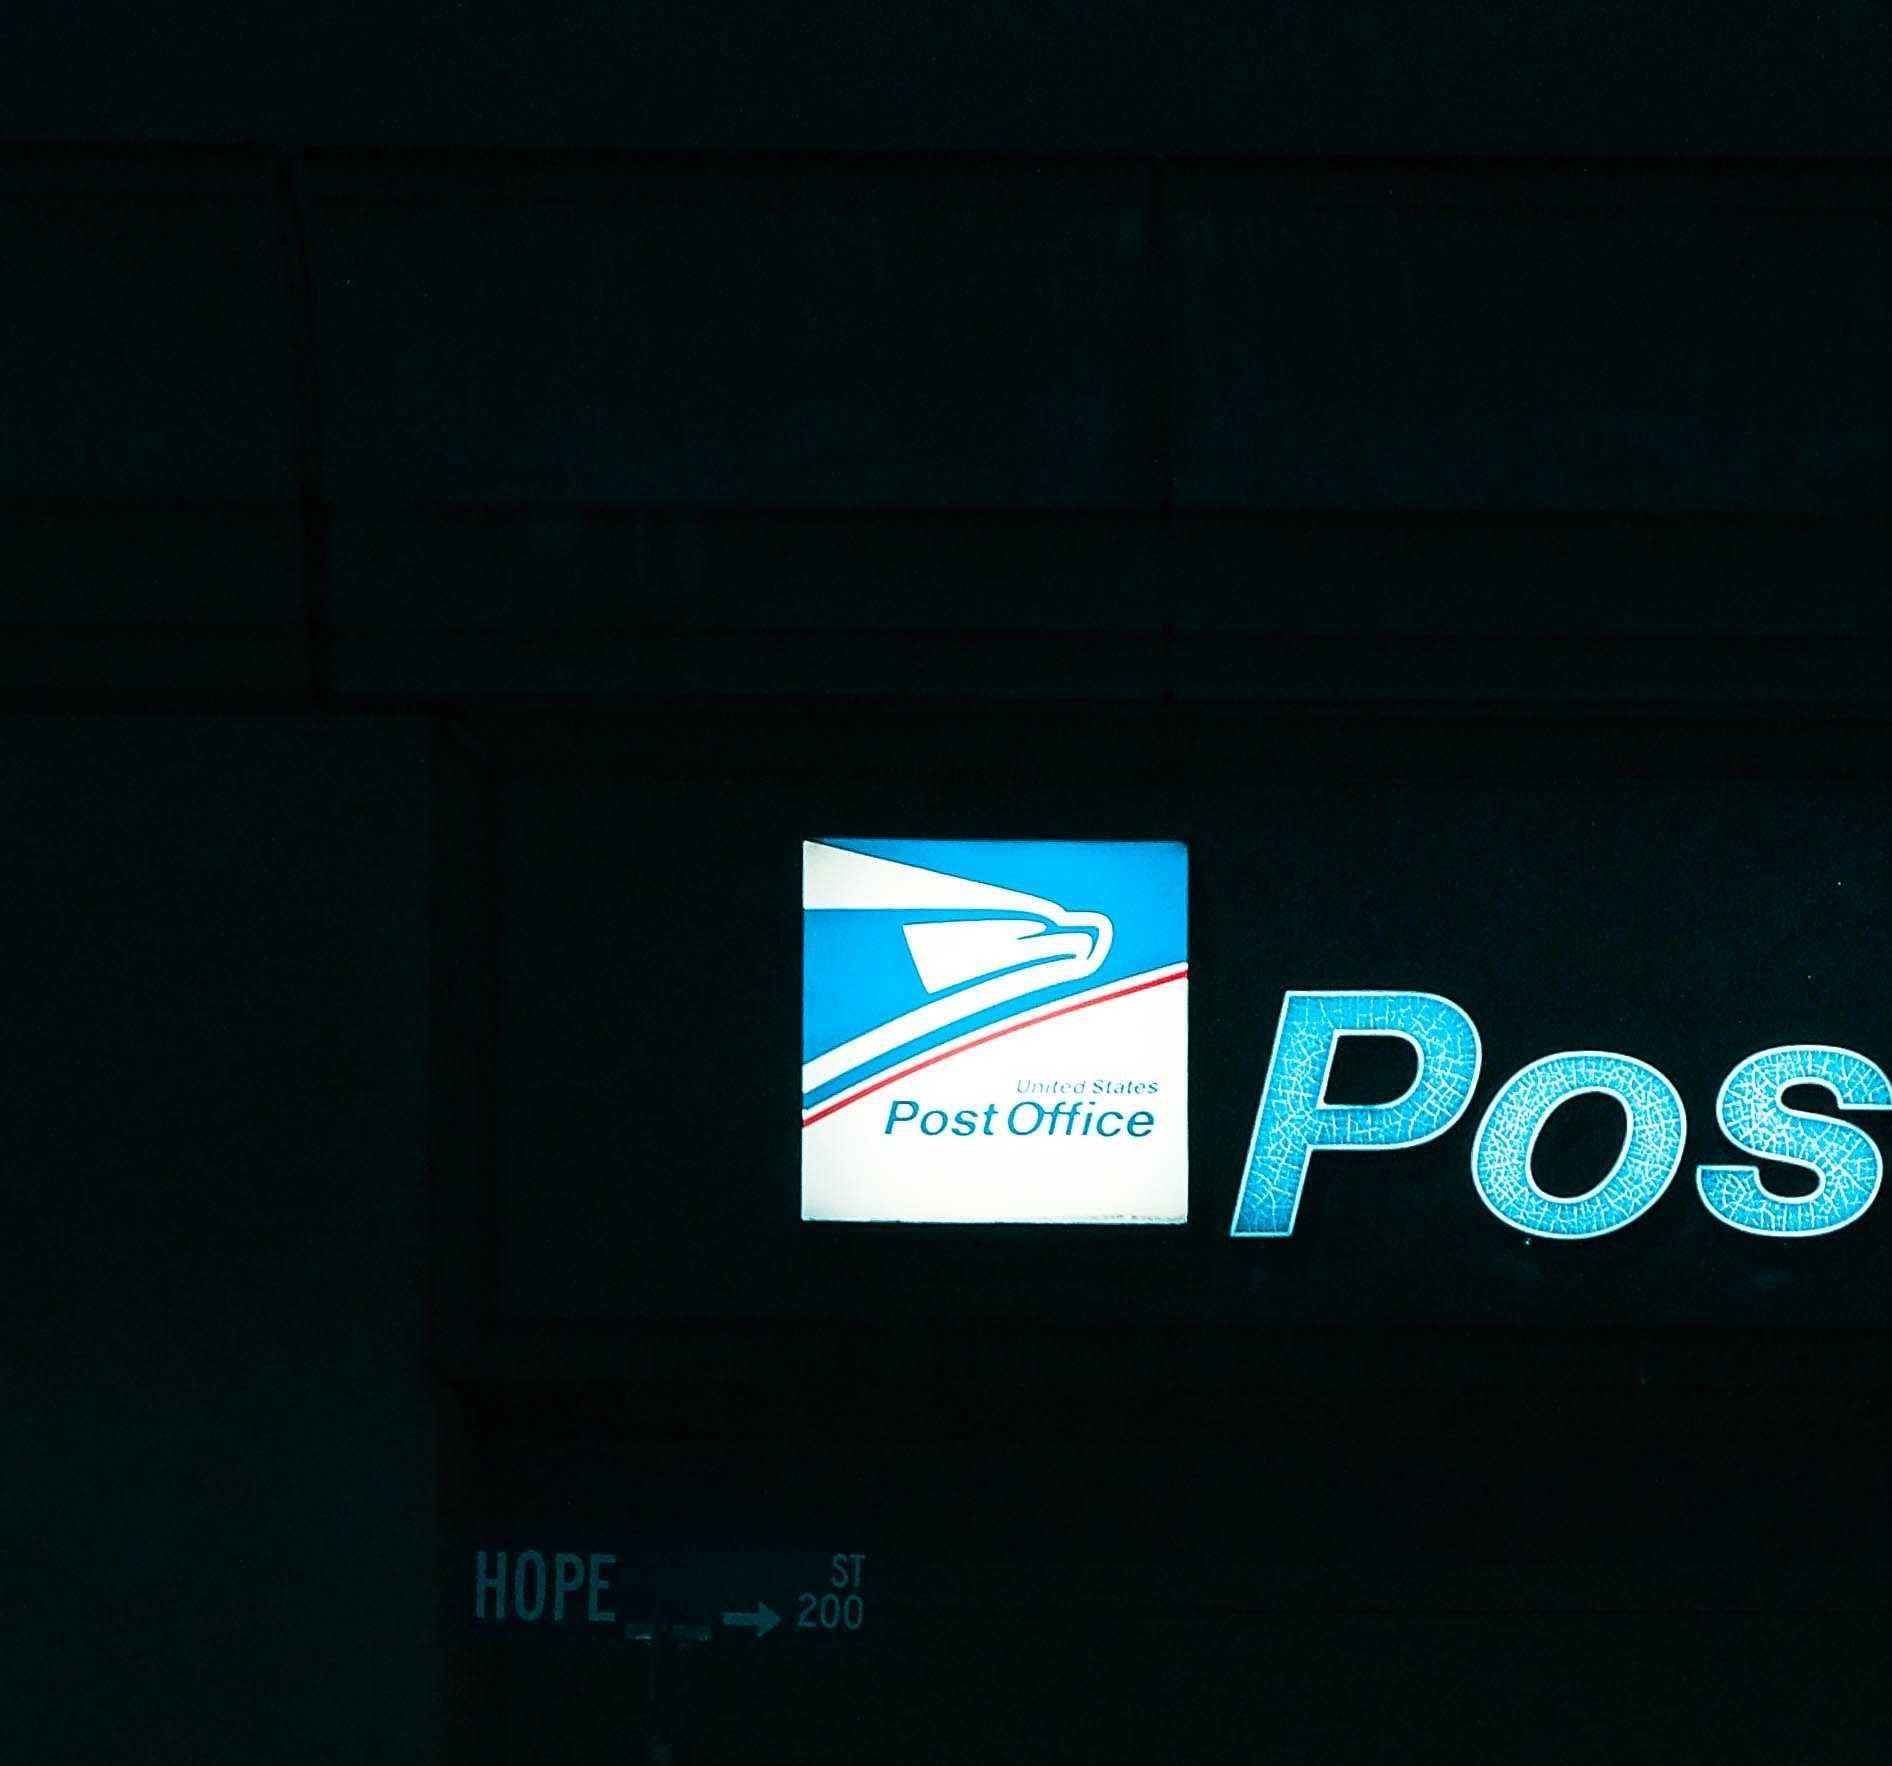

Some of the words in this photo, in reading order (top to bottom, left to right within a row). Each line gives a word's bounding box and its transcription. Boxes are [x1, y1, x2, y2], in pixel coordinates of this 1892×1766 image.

[1016, 1079, 1087, 1095] United
[1091, 1079, 1160, 1096] States
[884, 1099, 999, 1137] Post
[1007, 1100, 1155, 1138] Office
[474, 1549, 617, 1623] HOPE
[830, 1552, 868, 1589] ST
[797, 1593, 865, 1631] 200
